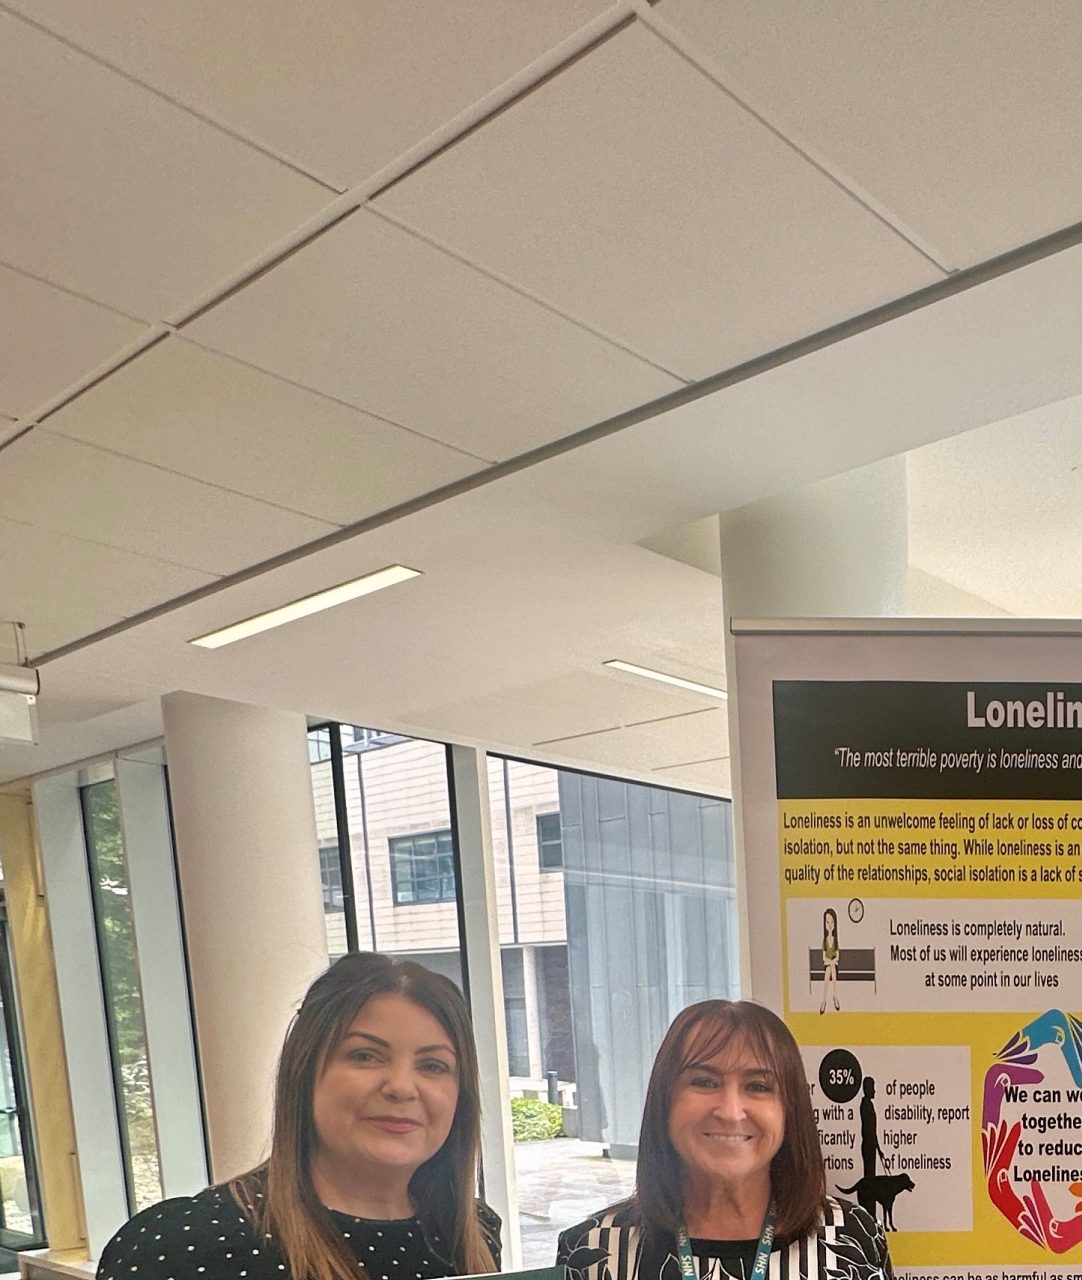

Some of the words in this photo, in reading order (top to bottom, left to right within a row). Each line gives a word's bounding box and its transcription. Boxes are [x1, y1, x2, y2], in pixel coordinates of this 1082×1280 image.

[863, 748, 894, 768] most
[896, 747, 937, 768] terrible
[939, 749, 985, 774] poverty
[986, 748, 997, 769] is
[999, 748, 1059, 769] loneliness
[889, 919, 949, 936] Loneliness
[951, 919, 961, 936] is
[963, 919, 1023, 941] completely
[1025, 919, 1066, 937] natural.
[890, 944, 917, 962] Most
[919, 944, 931, 962] of
[933, 948, 947, 962] us
[949, 945, 968, 962] will
[970, 945, 1029, 966] experience
[829, 1068, 855, 1085] 35%
[885, 1079, 897, 1096] of
[899, 1079, 936, 1100] people
[1004, 1086, 1028, 1104] We
[1032, 1090, 1061, 1103] can
[822, 1102, 845, 1121] with
[847, 1108, 854, 1121] a
[884, 1104, 935, 1125] disability,
[937, 1105, 970, 1124] report
[883, 1129, 918, 1149] higher
[1017, 1139, 1034, 1156] to
[884, 1154, 896, 1170] of
[897, 1153, 952, 1175] loneliness
[763, 1224, 775, 1246] NHS
[682, 1255, 694, 1276] NHS
[755, 1252, 768, 1274] NHS
